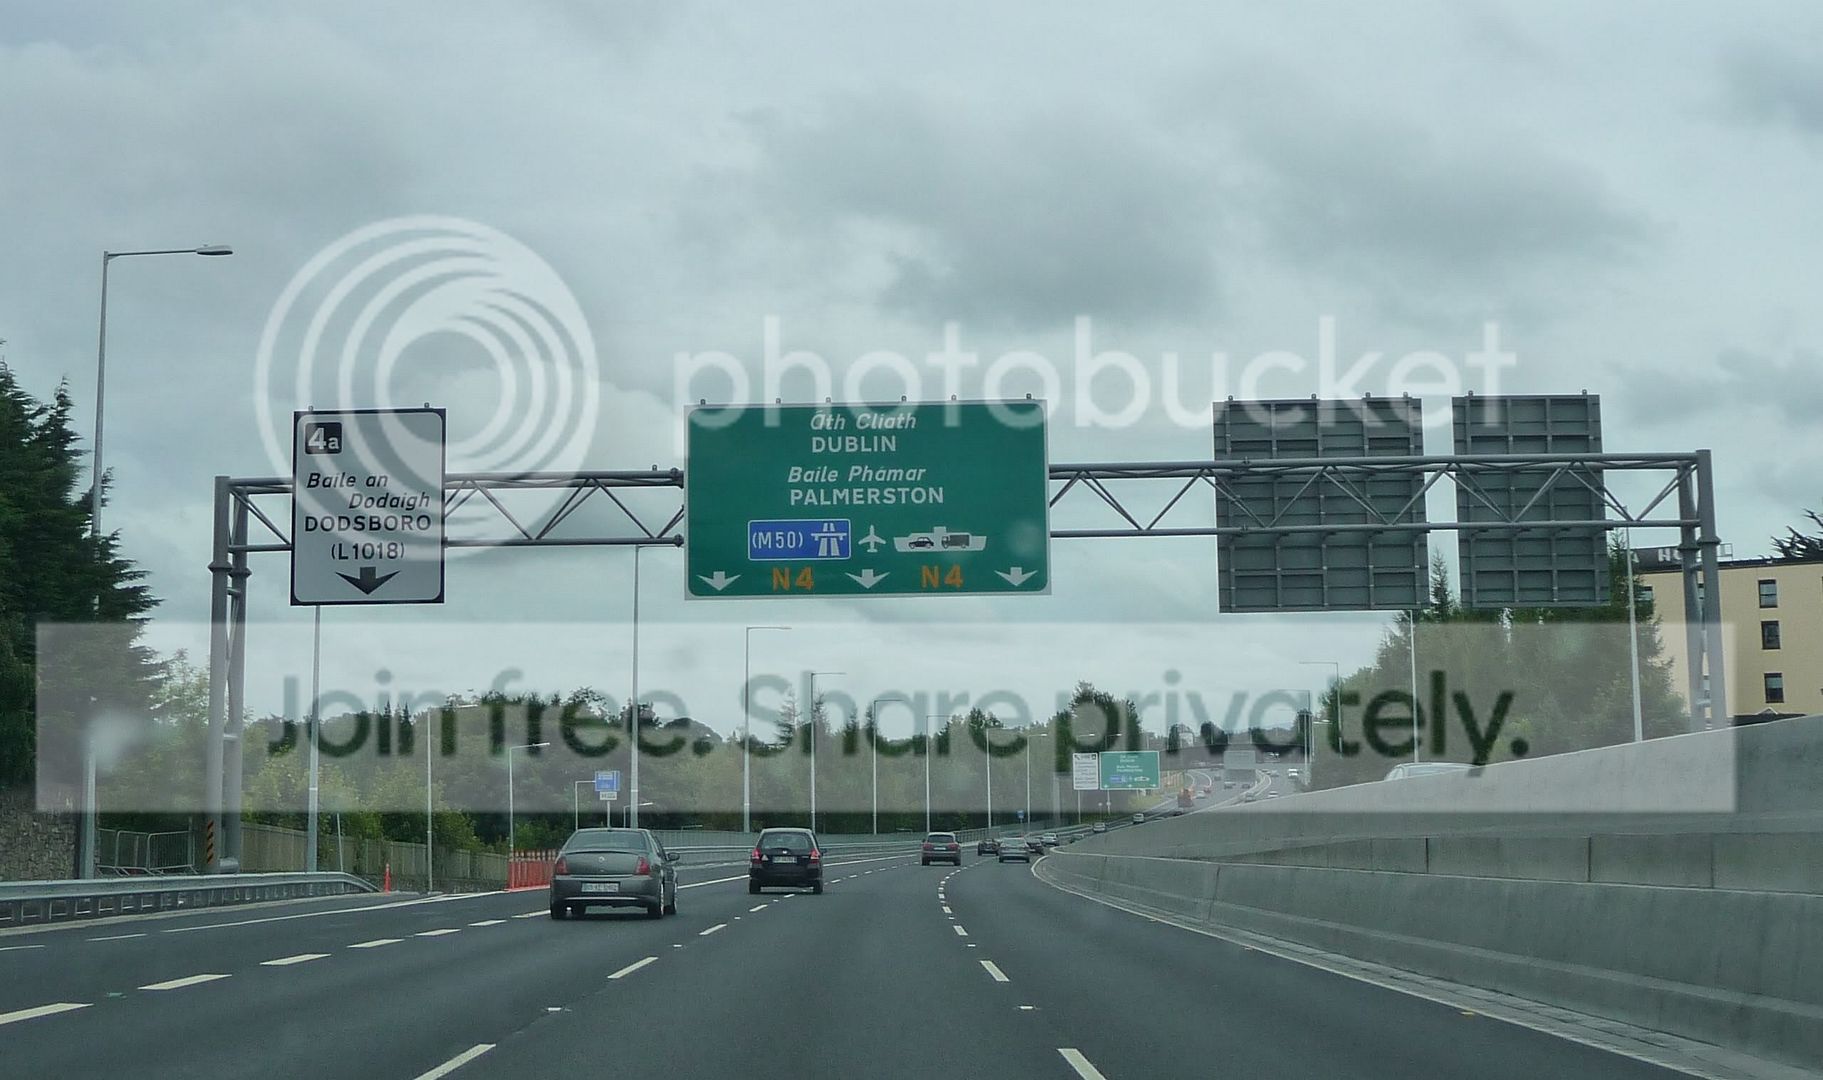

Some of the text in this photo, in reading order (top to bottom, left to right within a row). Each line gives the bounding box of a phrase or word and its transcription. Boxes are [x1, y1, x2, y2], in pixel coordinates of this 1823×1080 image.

[856, 413, 916, 430] Cliath
[307, 427, 340, 451] 4a
[811, 435, 897, 453] DUBLIN
[307, 472, 388, 488] Baile an
[788, 465, 926, 484] Baile Phámar
[349, 491, 430, 511] Dodaigh
[790, 487, 944, 506] PALMERSTON
[305, 515, 431, 533] DODSBORO
[331, 541, 405, 561] (L1018)
